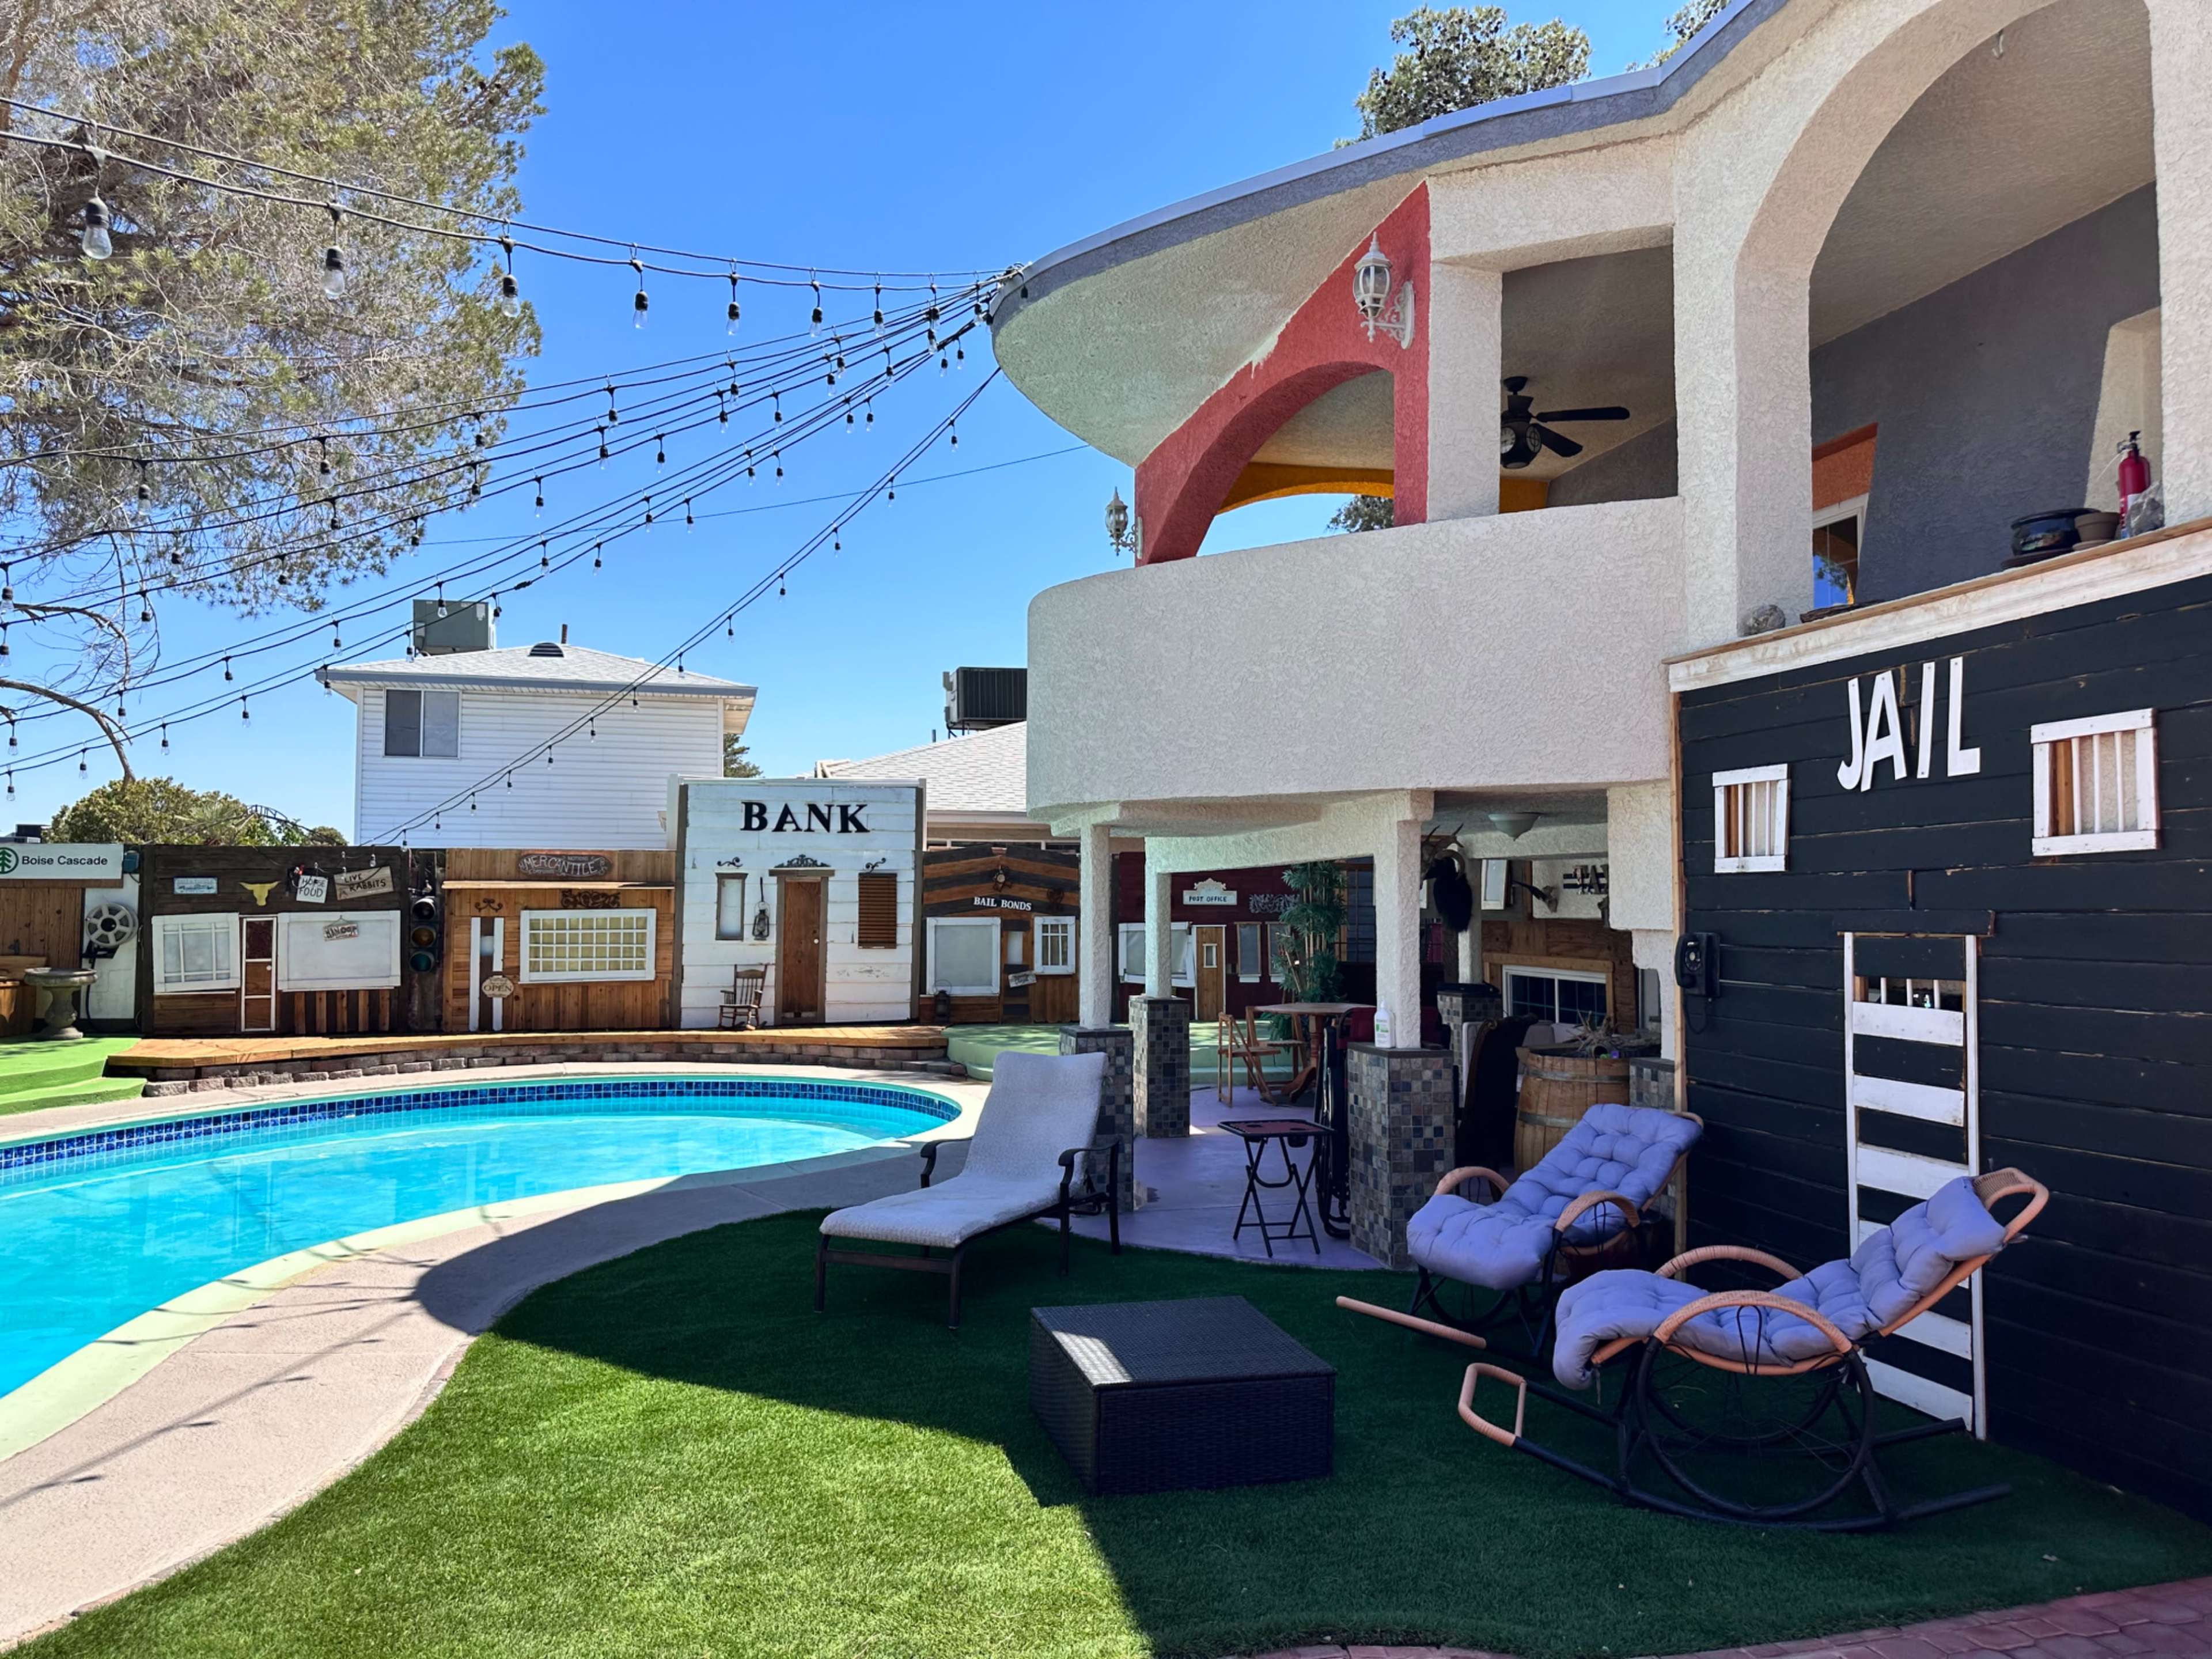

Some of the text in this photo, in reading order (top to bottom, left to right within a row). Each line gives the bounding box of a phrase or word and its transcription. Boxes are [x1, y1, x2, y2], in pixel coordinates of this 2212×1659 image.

[1837, 656, 1980, 792] JAIL
[740, 801, 871, 833] BANK
[22, 855, 108, 865] Boise Cascade
[524, 855, 598, 876] MERCANTILE
[344, 873, 363, 883] LIVE
[349, 878, 386, 892] RABBITS
[974, 897, 1032, 911] BAIL BONDS
